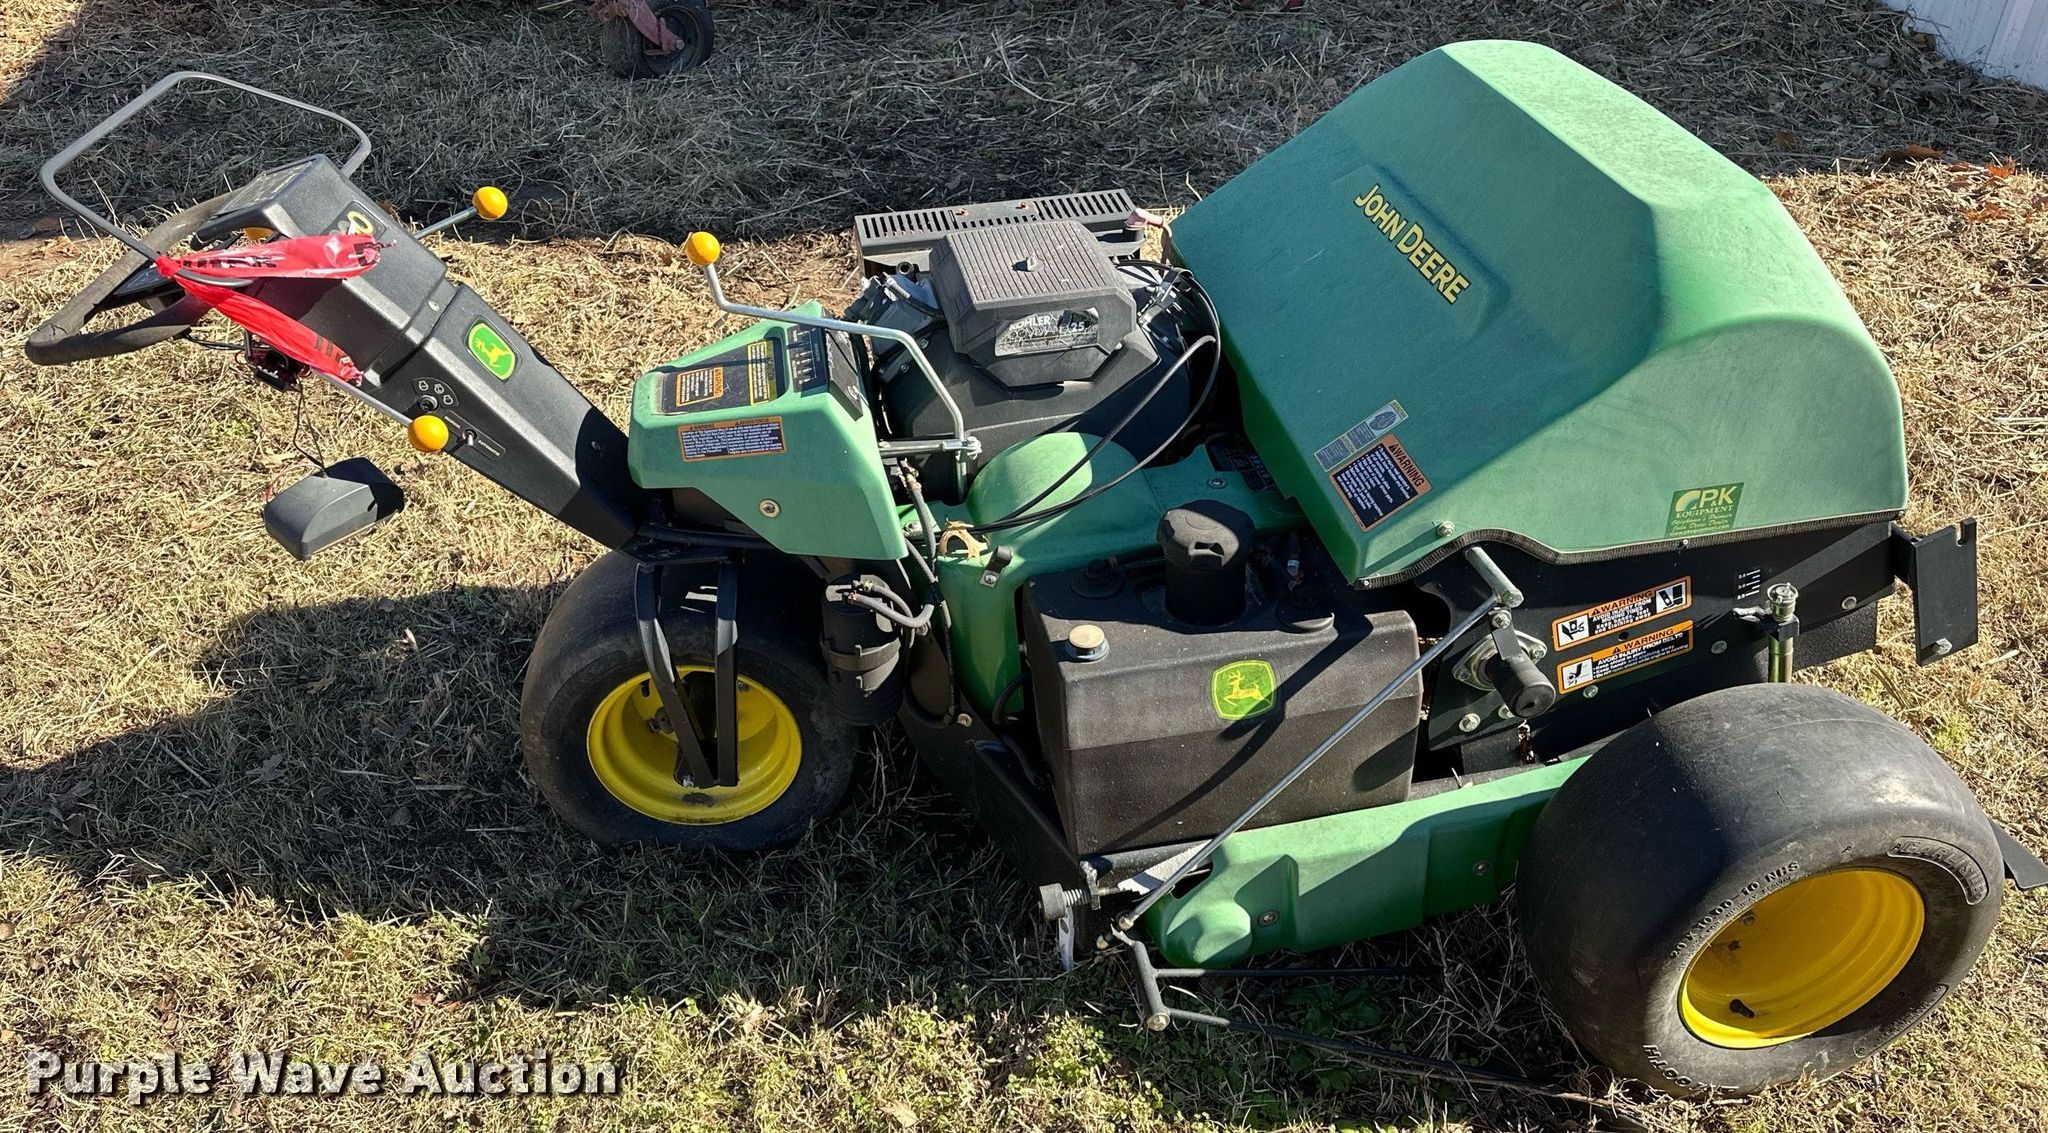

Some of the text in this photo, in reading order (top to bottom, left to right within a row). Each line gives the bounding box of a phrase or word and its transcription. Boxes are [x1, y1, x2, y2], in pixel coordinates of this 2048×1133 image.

[1354, 183, 1471, 305] JOHN DEERE
[1009, 315, 1052, 332] KOHLER
[1070, 322, 1084, 332] 25
[1392, 446, 1425, 487] WARNING
[1676, 504, 1734, 518] EQUIPMENT
[1592, 597, 1651, 622] AVOID INJURY FROM
[1602, 590, 1652, 612] WARNING
[1601, 605, 1643, 623] MOVING TINES
[1597, 632, 1683, 665] AVOID INJURY FROM BELTS
[1624, 628, 1673, 649] WARNING
[1763, 860, 1800, 883] NHS
